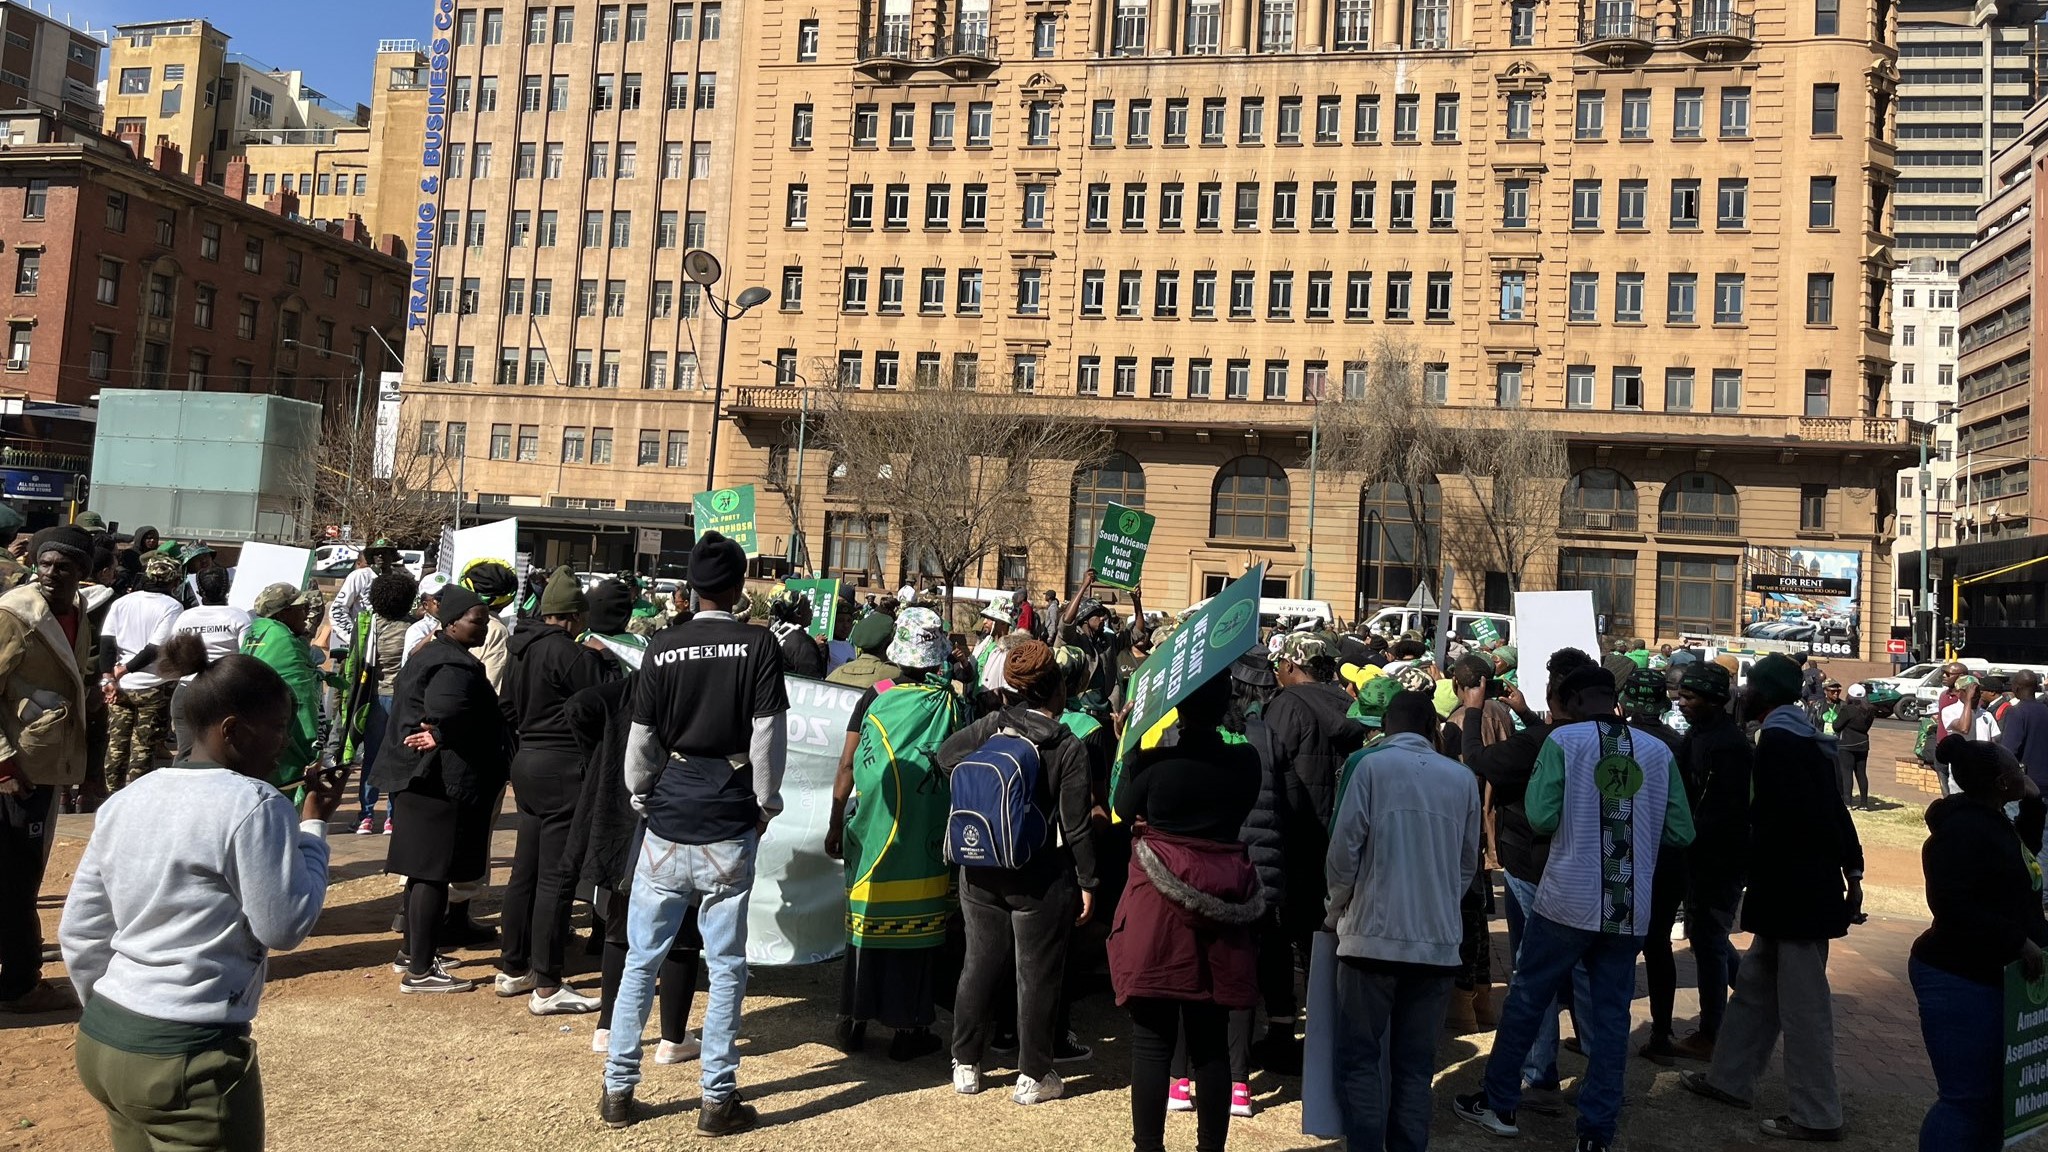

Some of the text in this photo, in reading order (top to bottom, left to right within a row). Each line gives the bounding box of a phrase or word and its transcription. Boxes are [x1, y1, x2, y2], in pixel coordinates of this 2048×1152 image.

[423, 37, 450, 166] BUSINESS
[421, 174, 439, 194] &
[409, 202, 437, 330] TRAINING
[700, 521, 753, 537] RMAPHOSA
[1100, 529, 1148, 550] South Africans
[1112, 545, 1131, 558] Voted
[1104, 555, 1132, 570] for MKP
[1101, 566, 1130, 582] Not GNU
[1779, 577, 1823, 587] FOR RENT
[813, 605, 821, 617] BY
[820, 593, 832, 629] LOSERS
[654, 646, 701, 667] VOTE
[718, 643, 749, 657] MK
[1187, 613, 1209, 680] WE CANT
[1813, 642, 1851, 654] 5866
[1166, 628, 1189, 700] BE RULED
[1151, 667, 1166, 692] BY
[1131, 668, 1151, 728] LOSERS
